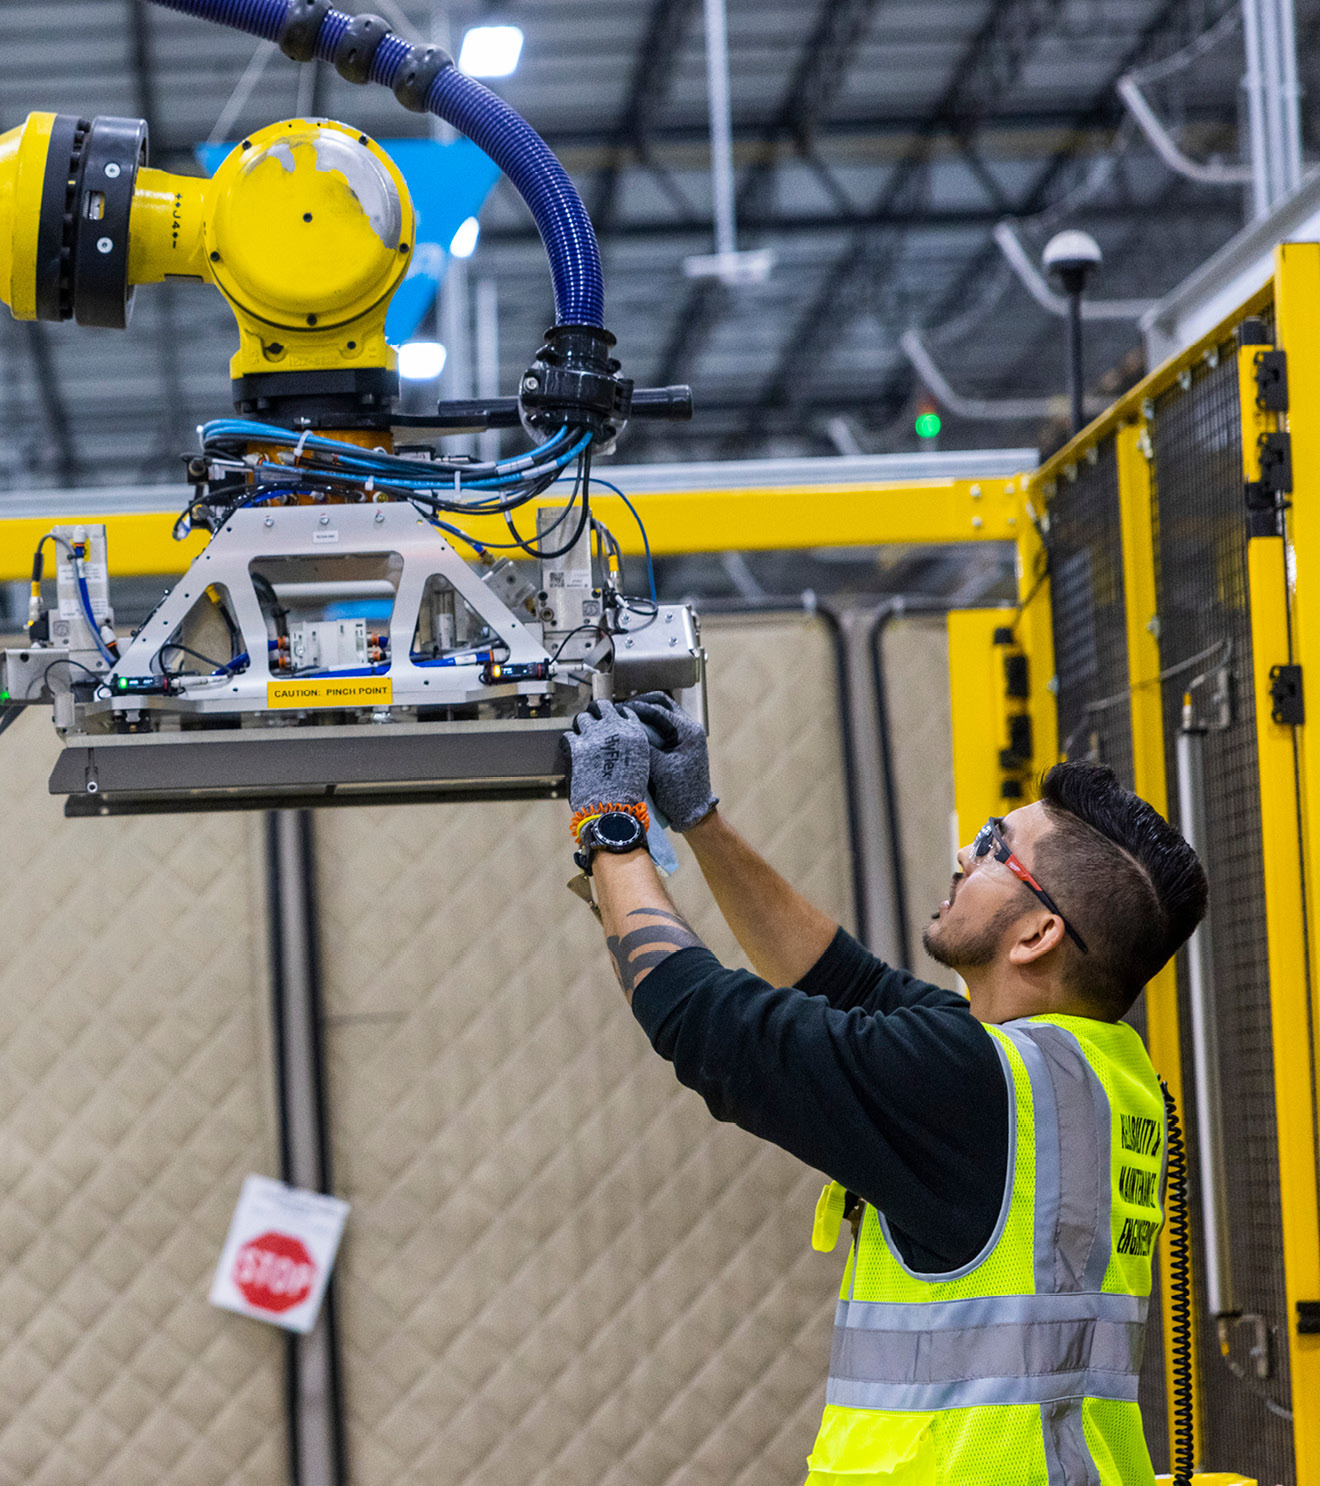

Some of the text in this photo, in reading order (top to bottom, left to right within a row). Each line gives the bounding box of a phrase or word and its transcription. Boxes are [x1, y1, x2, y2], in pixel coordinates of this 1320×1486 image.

[274, 686, 388, 698] CAUTION: PINCH POINT
[600, 733, 620, 778] HyFlex
[236, 1247, 313, 1295] STOP
